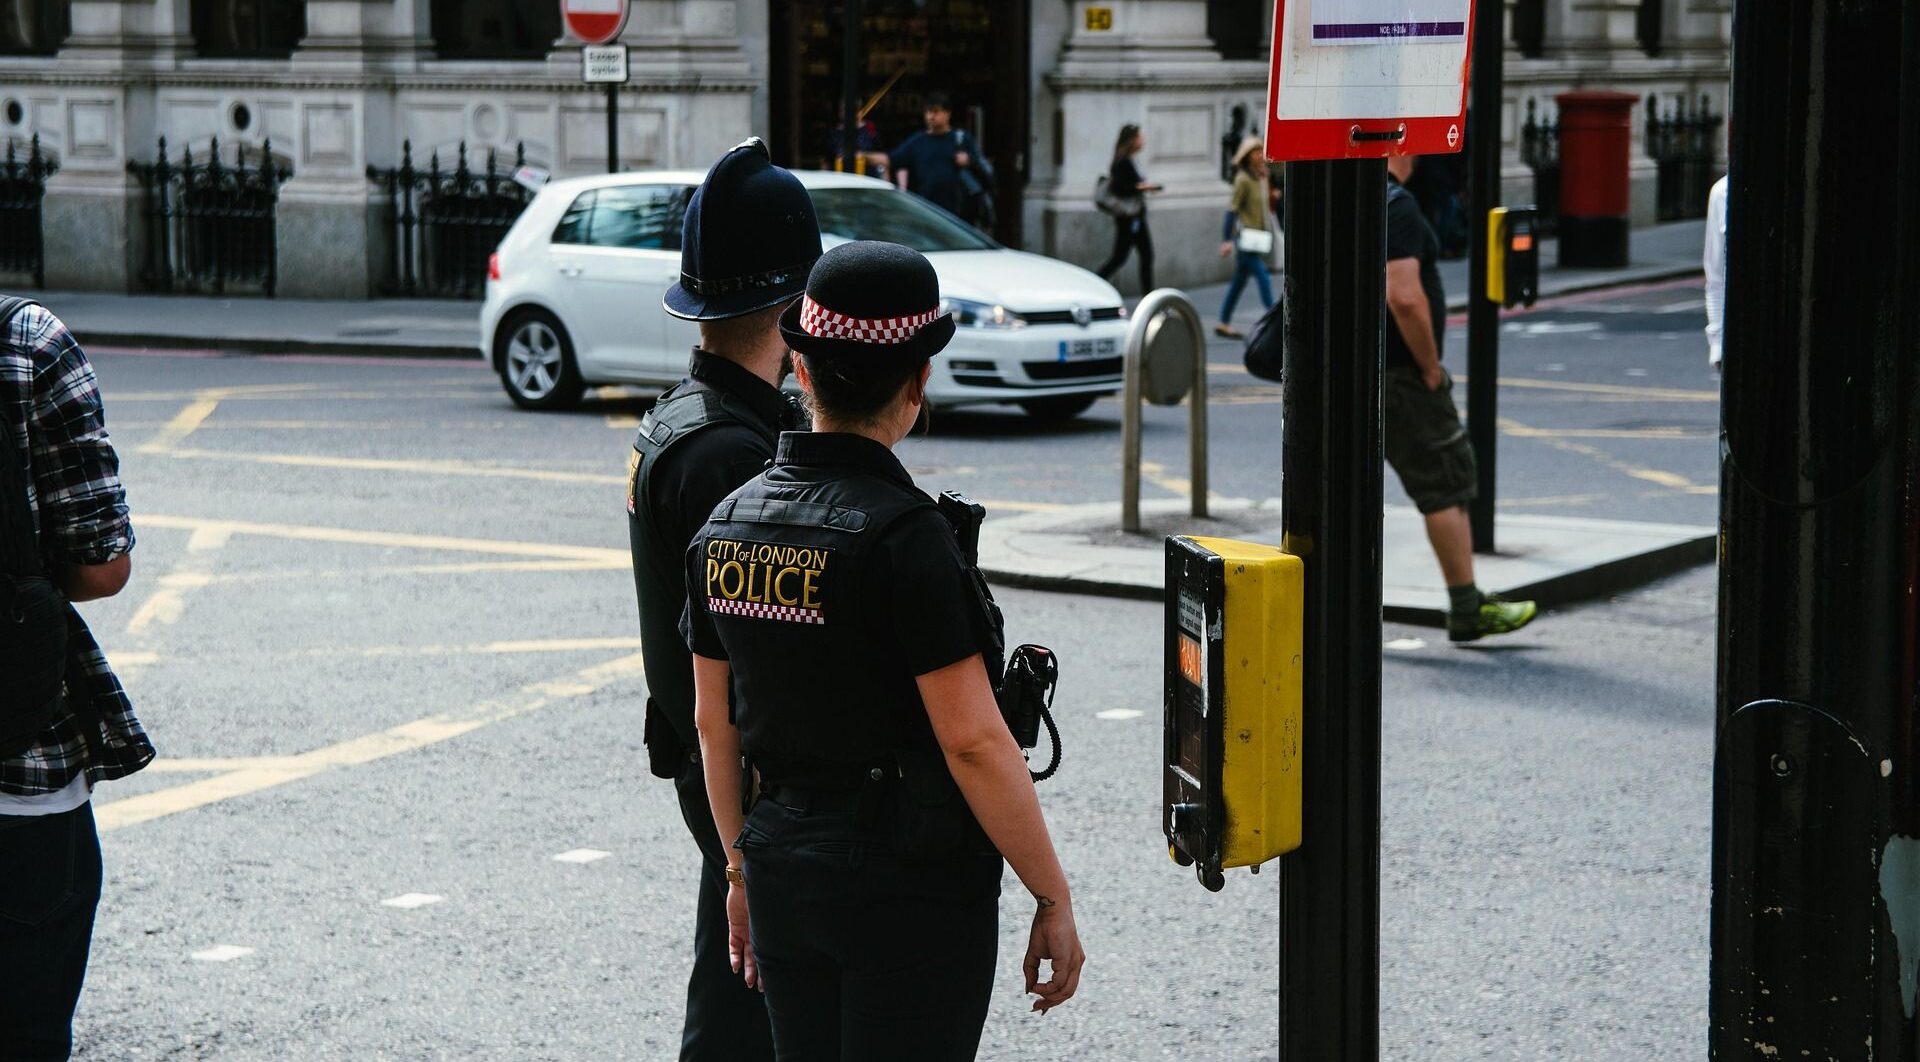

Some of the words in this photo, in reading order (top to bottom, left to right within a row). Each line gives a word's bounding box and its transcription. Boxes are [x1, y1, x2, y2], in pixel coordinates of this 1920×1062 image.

[707, 540, 742, 561] CITY
[738, 551, 750, 562] OF
[750, 543, 828, 569] LONDON
[706, 558, 822, 609] POLICE
